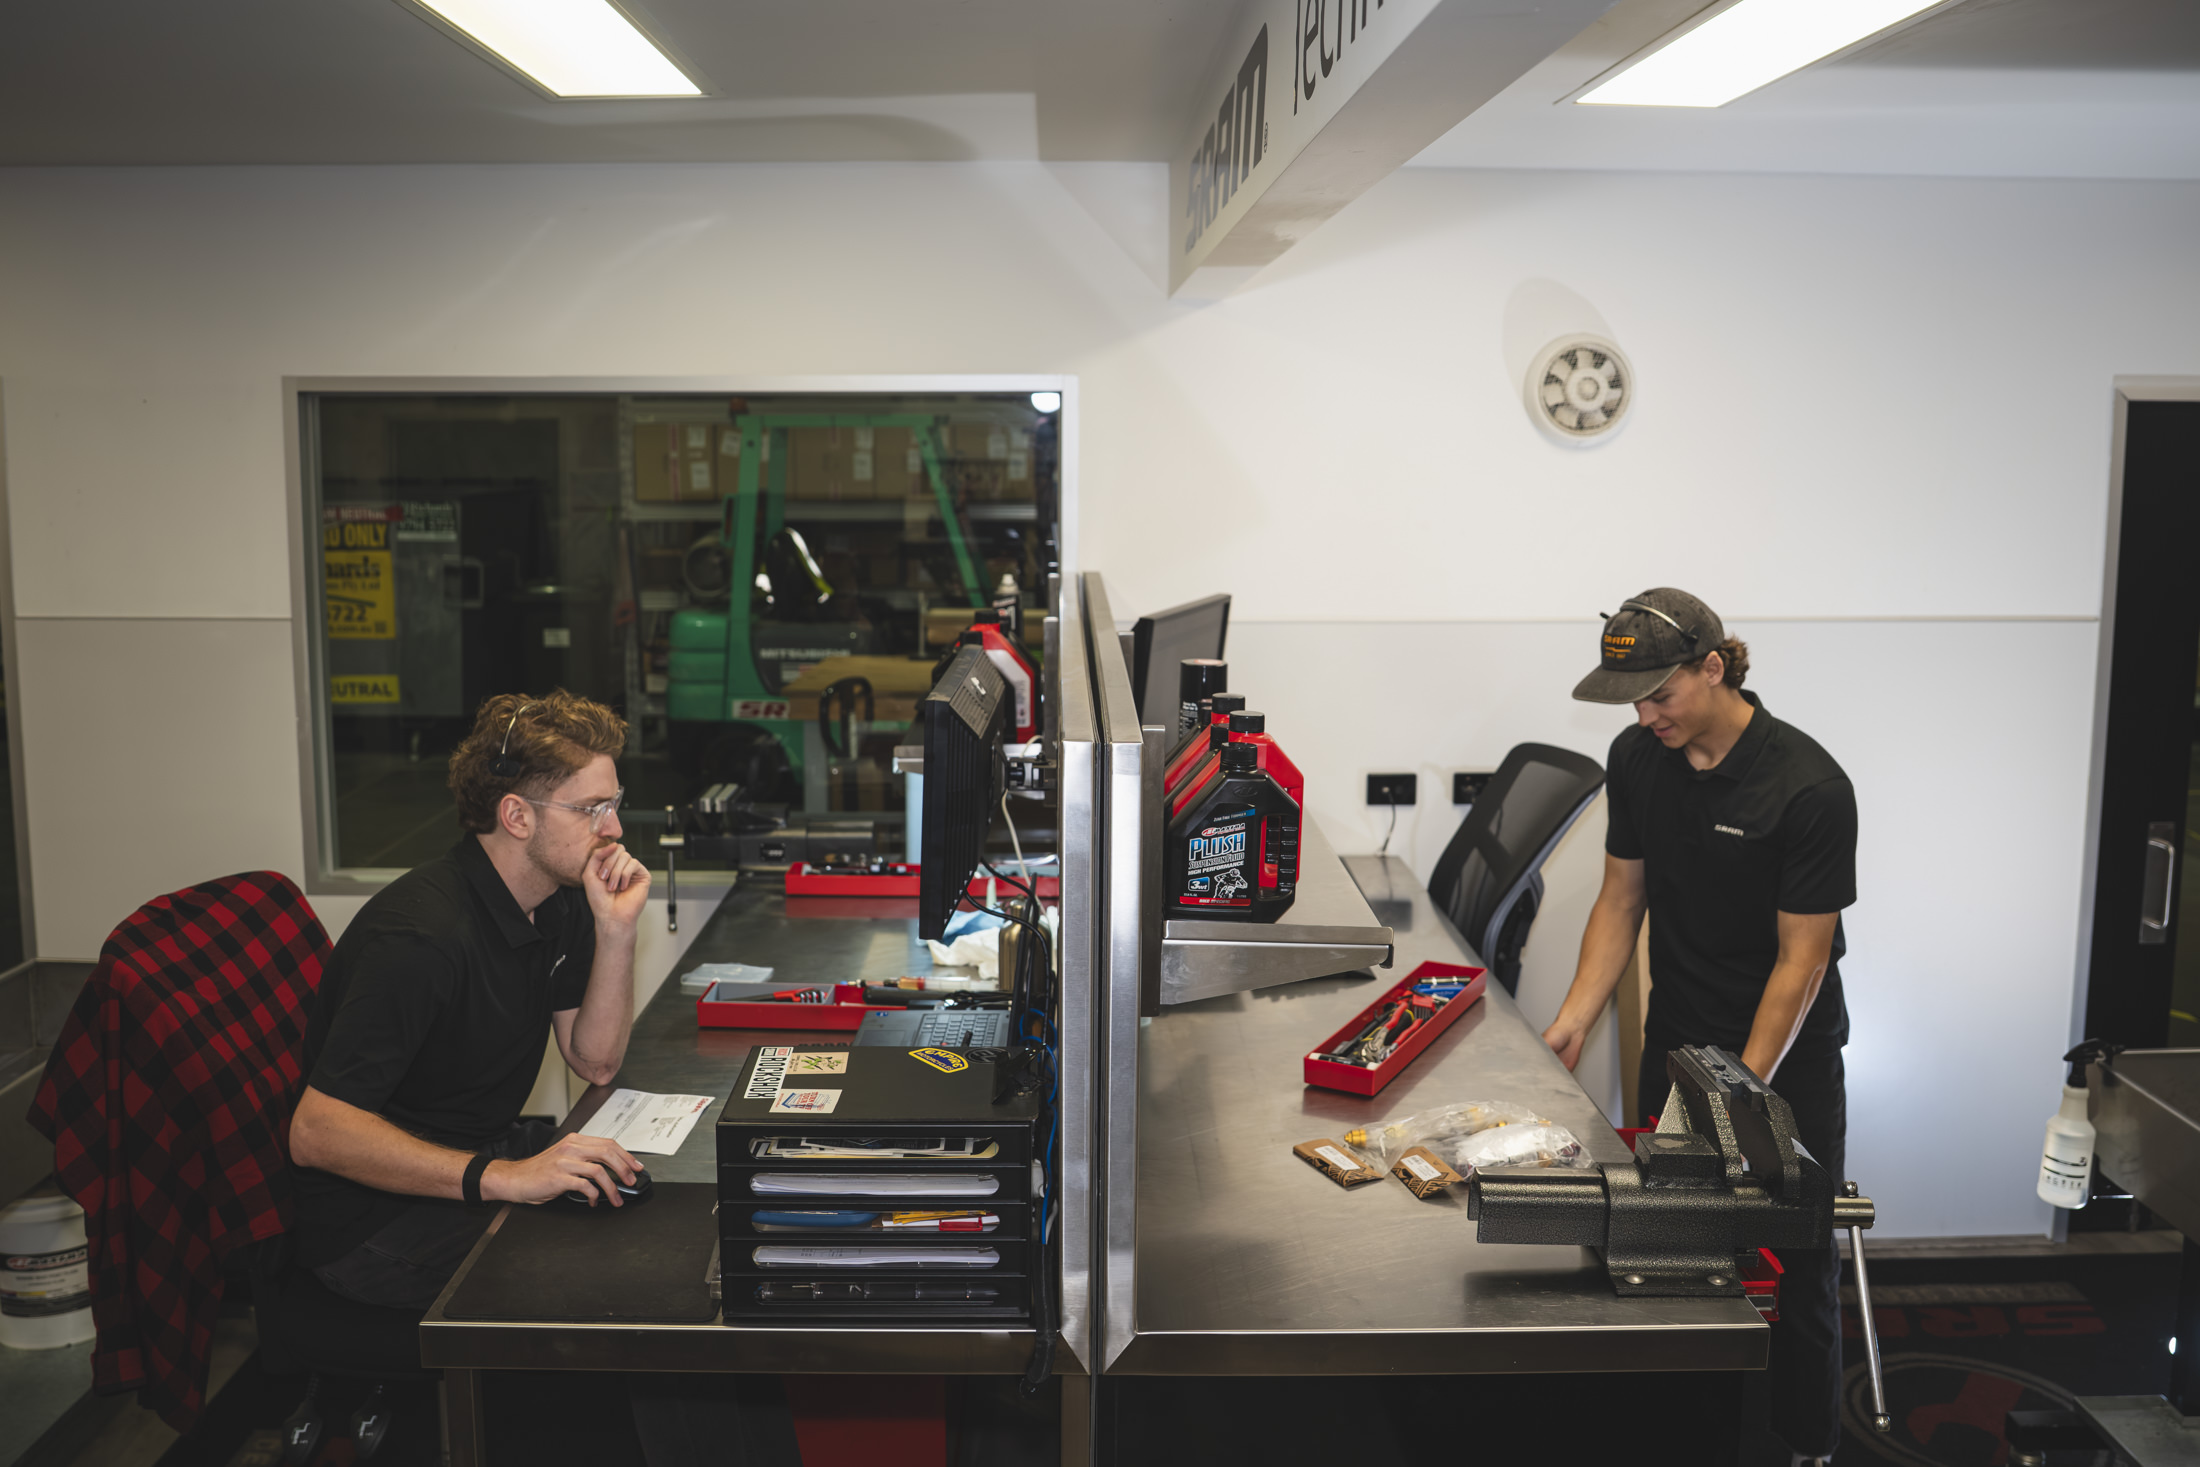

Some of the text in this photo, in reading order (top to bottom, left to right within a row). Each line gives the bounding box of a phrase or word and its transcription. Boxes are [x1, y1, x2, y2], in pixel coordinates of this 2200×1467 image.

[344, 523, 387, 547] ONLY
[328, 604, 367, 622] 722
[1604, 634, 1636, 646] SRAM
[333, 681, 393, 698] UTRAL
[1714, 824, 1744, 837] SRAM
[1188, 831, 1246, 862] PLUSH
[1202, 860, 1245, 873] PERFORMANCE
[747, 1057, 788, 1098] ROCKSHOX
